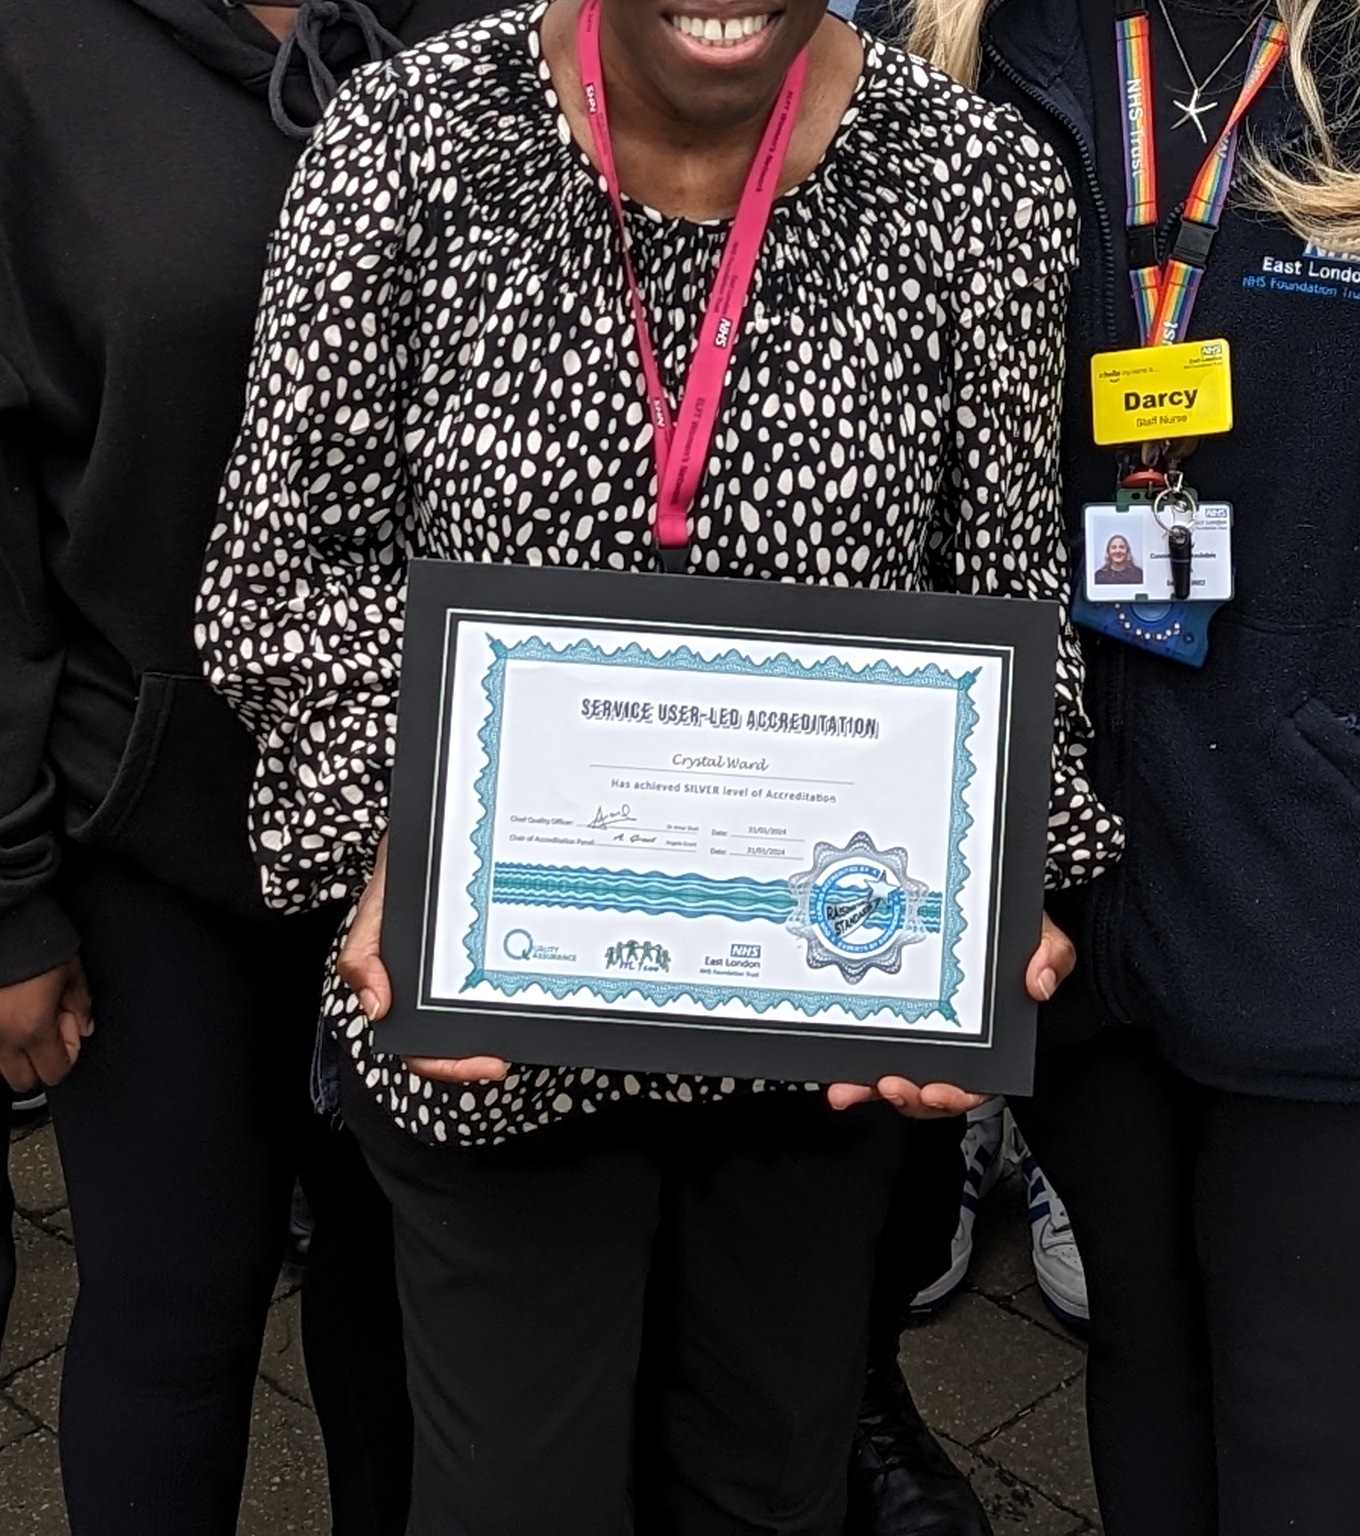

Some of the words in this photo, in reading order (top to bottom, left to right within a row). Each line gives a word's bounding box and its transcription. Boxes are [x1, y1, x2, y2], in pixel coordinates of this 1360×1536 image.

[1126, 78, 1144, 121] NHS
[1129, 125, 1145, 178] Trust
[1262, 255, 1303, 276] East
[1242, 275, 1267, 288] NHS
[1270, 277, 1338, 297] Foundation
[715, 317, 732, 348] NHS
[1123, 388, 1199, 412] Darcy
[1136, 416, 1158, 428] Staff
[1159, 415, 1188, 425] Nurse
[581, 698, 653, 723] SERVICE
[657, 703, 741, 728] USER-LED
[745, 710, 880, 740] ACCREDITATION
[671, 753, 726, 770] Crystal
[726, 756, 770, 772] Ward
[611, 778, 631, 789] Has
[633, 780, 681, 793] achieved
[684, 783, 720, 796] SILVER
[722, 785, 749, 798] level
[751, 787, 763, 799] of
[765, 789, 837, 804] Accreditation
[704, 955, 723, 967] East
[725, 958, 761, 969] London
[731, 944, 761, 958] NHS
